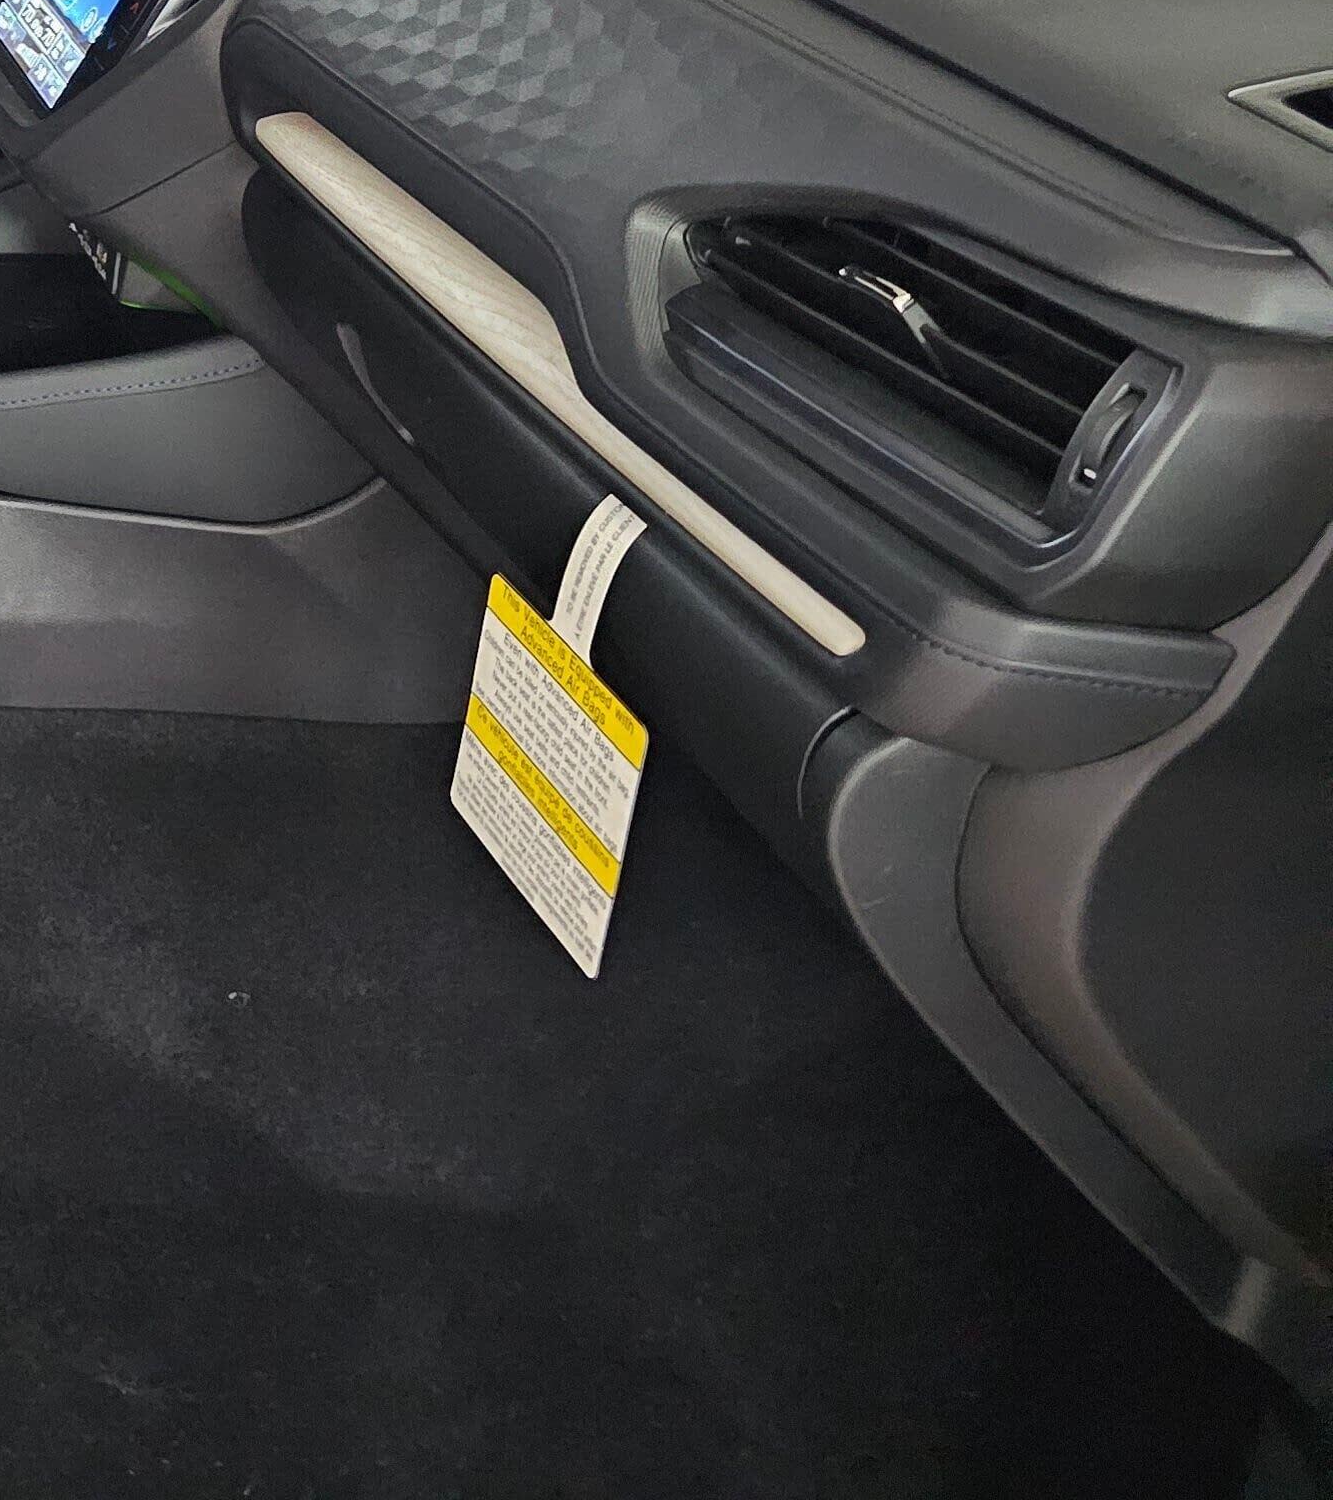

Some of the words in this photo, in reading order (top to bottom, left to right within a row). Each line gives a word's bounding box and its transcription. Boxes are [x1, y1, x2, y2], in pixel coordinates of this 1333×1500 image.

[574, 545, 593, 589] REMOVED
[591, 533, 599, 546] BY
[502, 584, 520, 613] This
[524, 607, 555, 650] Vehicle
[557, 643, 567, 662] is
[567, 654, 612, 715] Equipped
[614, 702, 635, 735] with
[503, 631, 523, 661] Even
[524, 653, 540, 680] with
[540, 671, 579, 723] Advanced
[580, 714, 592, 738] Air
[593, 729, 615, 767] Bags
[520, 623, 564, 680] Advanced
[566, 672, 580, 697] Air
[581, 689, 606, 731] Bags
[476, 702, 488, 724] Ce
[561, 803, 573, 825] de
[573, 817, 610, 869] coussins
